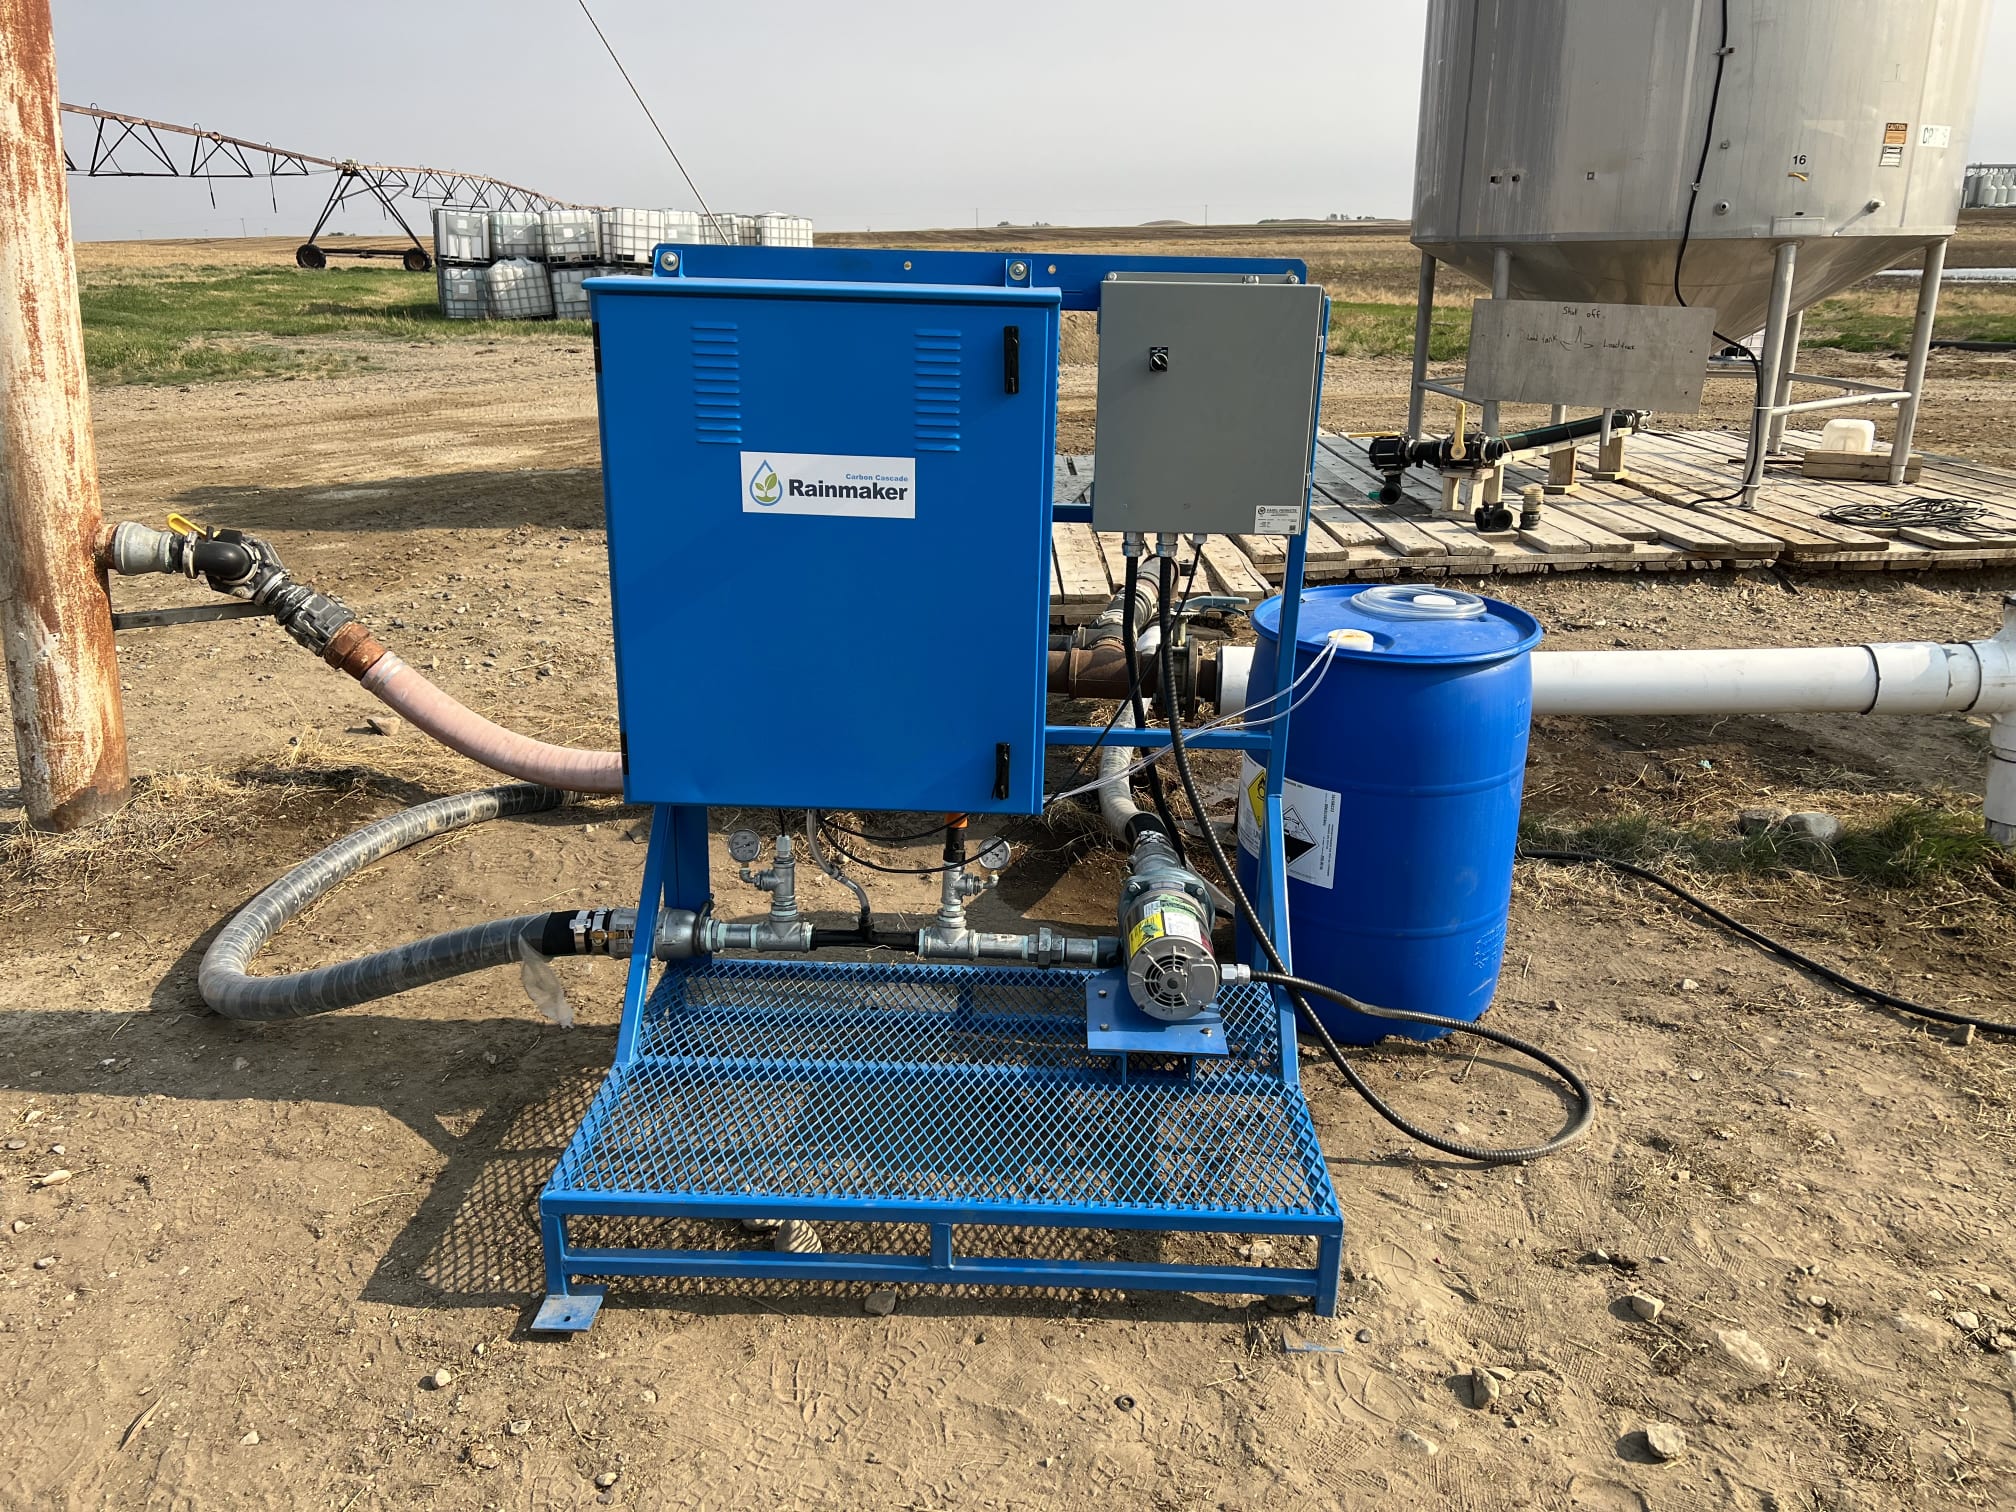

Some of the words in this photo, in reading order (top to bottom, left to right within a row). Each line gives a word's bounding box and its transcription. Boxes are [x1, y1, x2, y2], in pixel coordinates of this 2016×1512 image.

[1793, 154, 1807, 165] 16
[1586, 308, 1601, 319] off
[845, 473, 873, 481] Carbon
[875, 474, 909, 482] Cascade
[788, 478, 908, 501] Rainmaker
